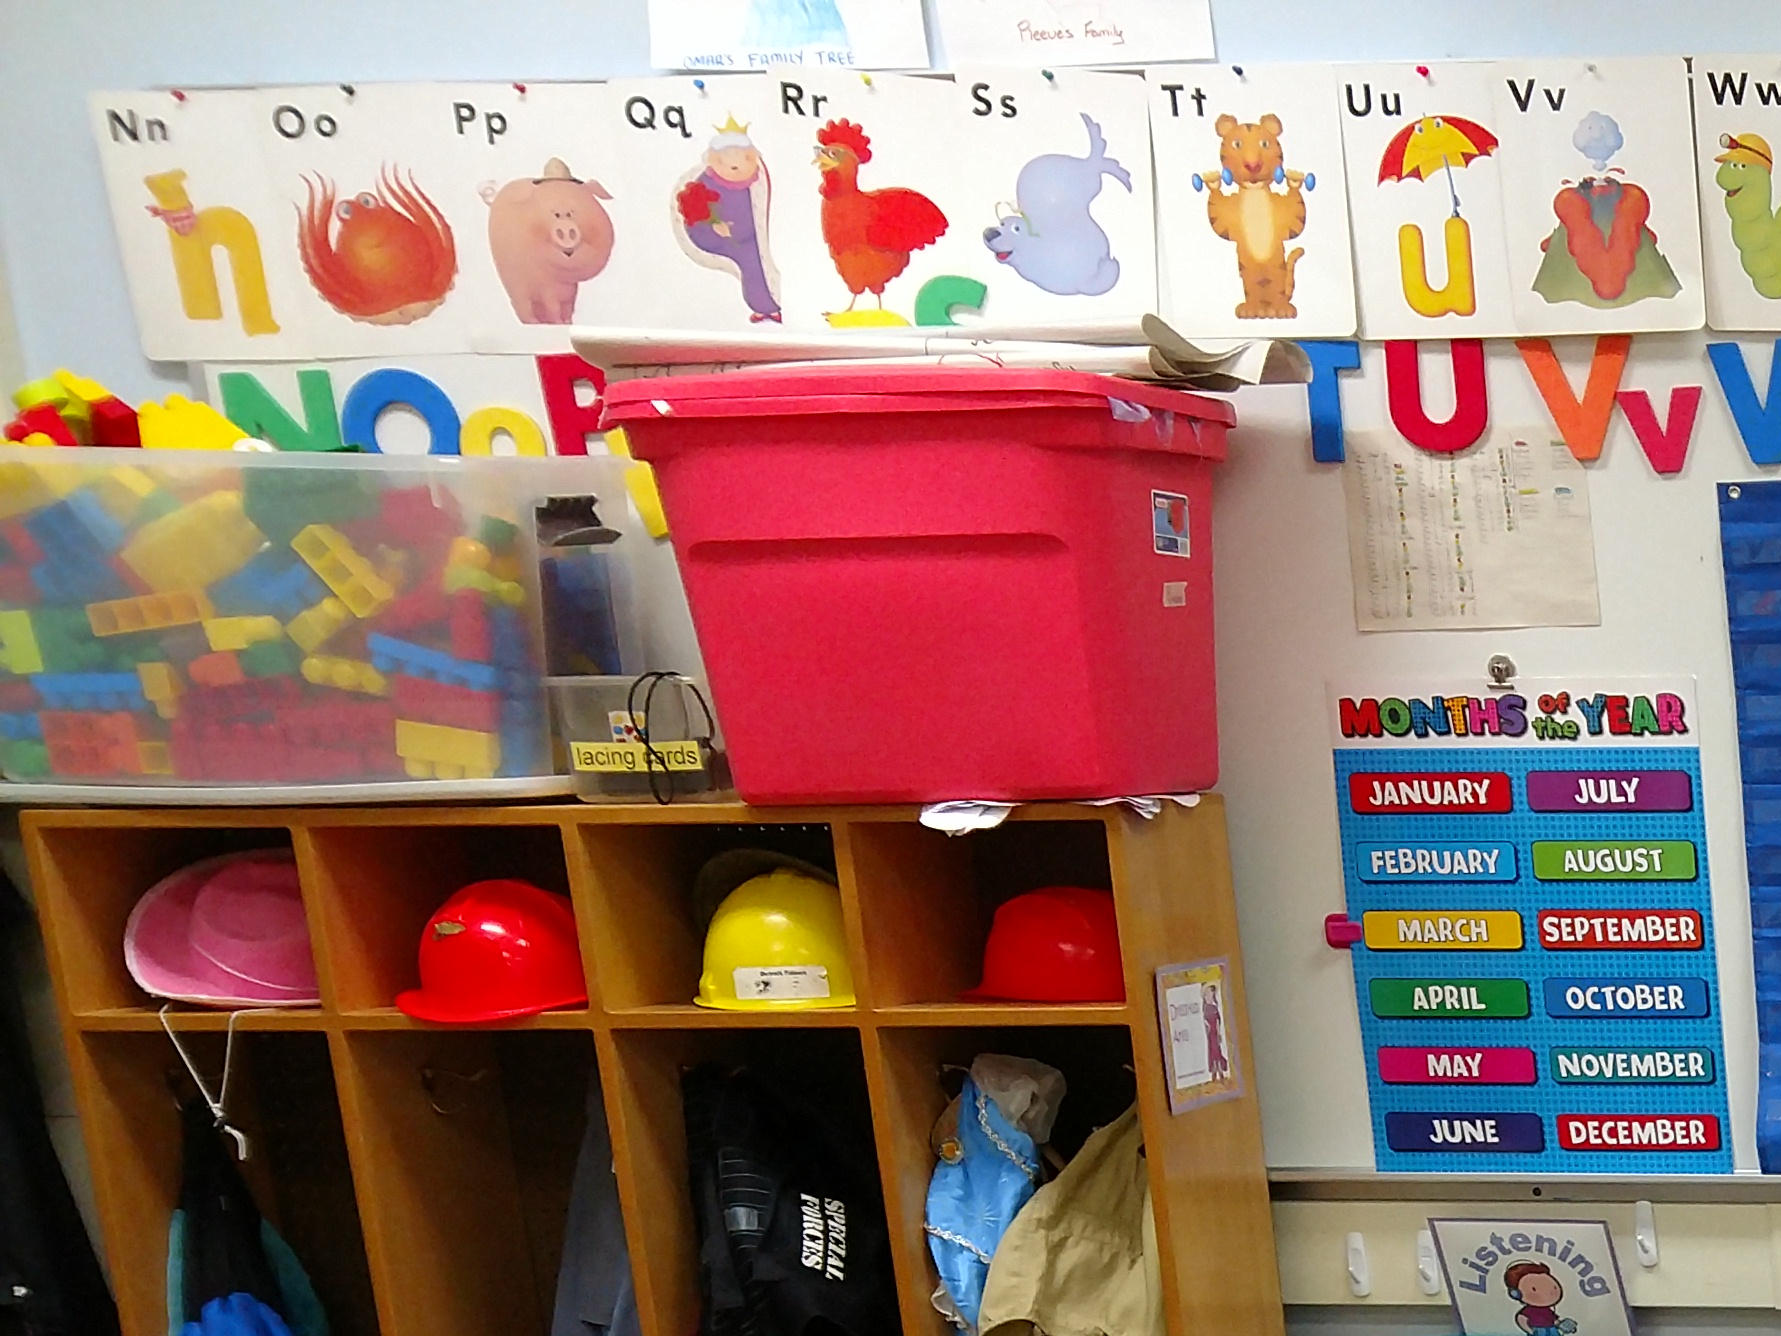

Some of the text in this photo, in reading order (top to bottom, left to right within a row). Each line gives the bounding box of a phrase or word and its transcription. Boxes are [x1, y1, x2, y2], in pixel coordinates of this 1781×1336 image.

[1084, 21, 1125, 46] Family
[748, 50, 803, 66] FAMILY
[813, 50, 856, 66] TREE
[780, 81, 829, 119] Rr
[970, 82, 1018, 119] Ss
[1160, 83, 1208, 118] Tt
[1344, 83, 1402, 117] Uu
[1506, 78, 1567, 113] Vv
[107, 108, 169, 143] Nn
[271, 104, 338, 140] Oo
[452, 101, 508, 144] Pp
[625, 95, 692, 138] Qq
[1339, 692, 1529, 739] MONTHS
[1532, 715, 1581, 742] the
[1576, 691, 1690, 737] YEAR
[576, 746, 636, 770] lacing
[1368, 777, 1640, 806] JANUARY JULY
[1370, 847, 1665, 876] FEBRUARY AUGUST
[1397, 915, 1698, 943] MARCH SEPTEMBER
[1412, 983, 1686, 1011] APRIL OCTOBER
[1427, 1052, 1706, 1080] MAY NOVEMBER
[1429, 1118, 1706, 1146] JUNE DECEMBER
[800, 1193, 824, 1271] FORCES
[824, 1197, 847, 1282] SPECIAL
[1458, 1231, 1612, 1298] Listening
